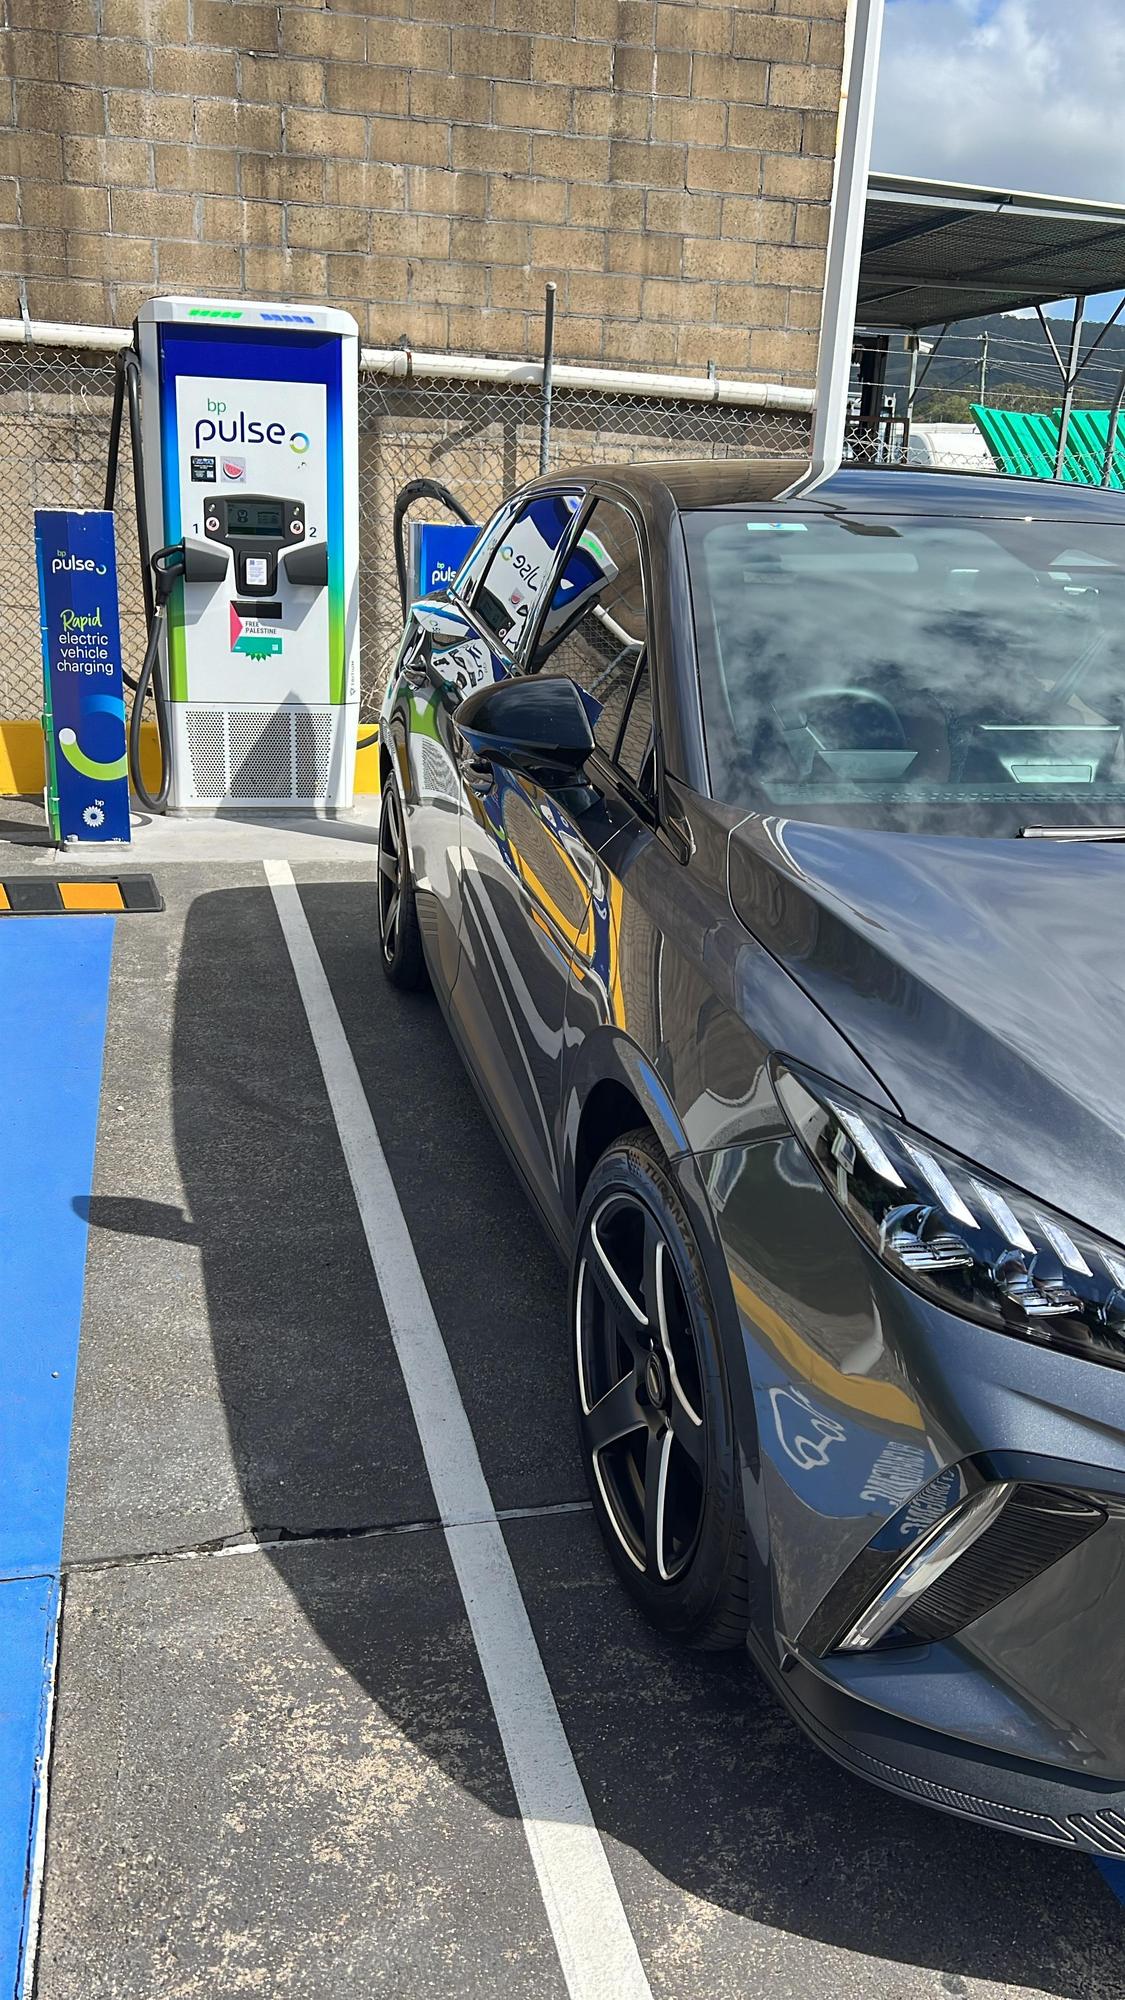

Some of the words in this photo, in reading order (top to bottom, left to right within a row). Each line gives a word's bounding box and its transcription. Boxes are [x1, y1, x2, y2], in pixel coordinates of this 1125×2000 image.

[207, 398, 227, 415] bp
[195, 411, 286, 449] pulse
[193, 523, 199, 534] 1
[309, 527, 317, 538] 2
[57, 550, 66, 559] bp
[52, 555, 95, 573] pulse
[437, 561, 445, 569] bp
[432, 566, 456, 585] puls
[60, 607, 103, 632] Rapid
[245, 620, 260, 628] FREE
[245, 627, 277, 635] PALESTINE
[59, 632, 109, 645] electric
[60, 645, 108, 659] vehicle
[56, 659, 114, 675] charging
[95, 799, 105, 807] bp
[645, 1162, 697, 1261] TURANZA
